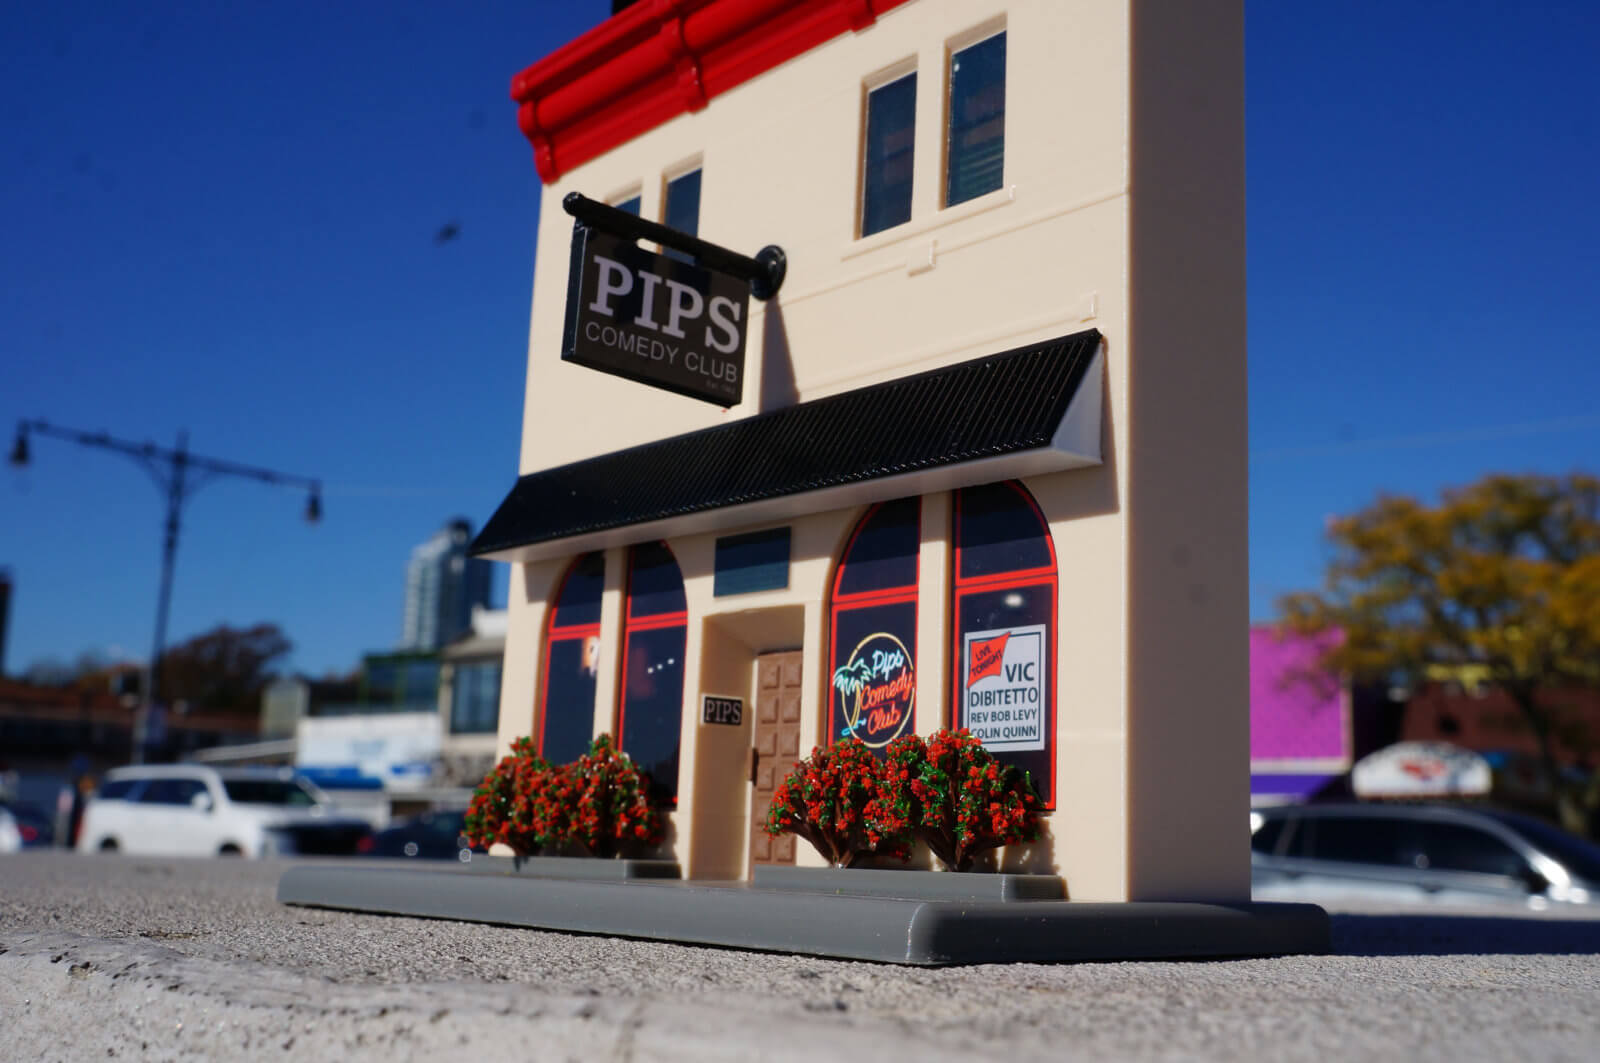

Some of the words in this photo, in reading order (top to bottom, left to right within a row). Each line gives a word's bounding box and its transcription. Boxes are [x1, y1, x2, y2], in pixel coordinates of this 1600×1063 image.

[589, 255, 741, 354] PIPS
[585, 321, 679, 365] COMEDY
[684, 351, 738, 383] CLUB
[871, 649, 904, 681] Pips
[1005, 662, 1034, 682] VIC
[860, 665, 913, 711] Comedy
[970, 687, 1038, 707] DIBITETTO
[706, 700, 741, 724] PIPS
[867, 701, 901, 735] Club
[971, 711, 989, 723] REV
[991, 710, 1011, 722] BOB
[1013, 708, 1037, 721] LEVY
[971, 727, 1001, 739] COLIN
[1003, 725, 1037, 739] QUINN
